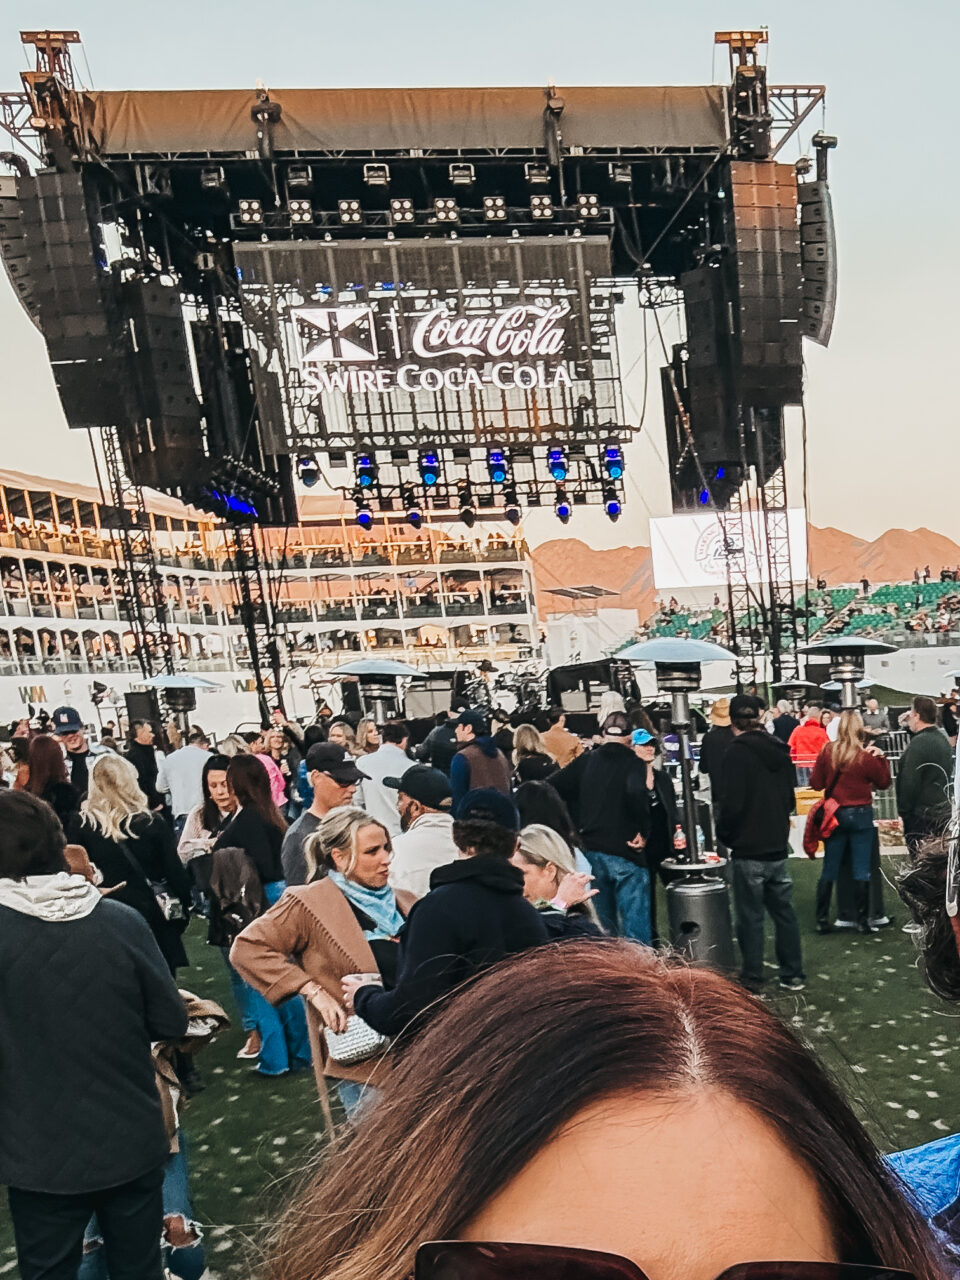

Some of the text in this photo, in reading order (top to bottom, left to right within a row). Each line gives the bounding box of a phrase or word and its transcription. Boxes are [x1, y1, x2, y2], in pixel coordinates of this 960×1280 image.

[412, 299, 571, 358] Coca-Cola
[301, 361, 573, 395] SWIRE COCA-COLA
